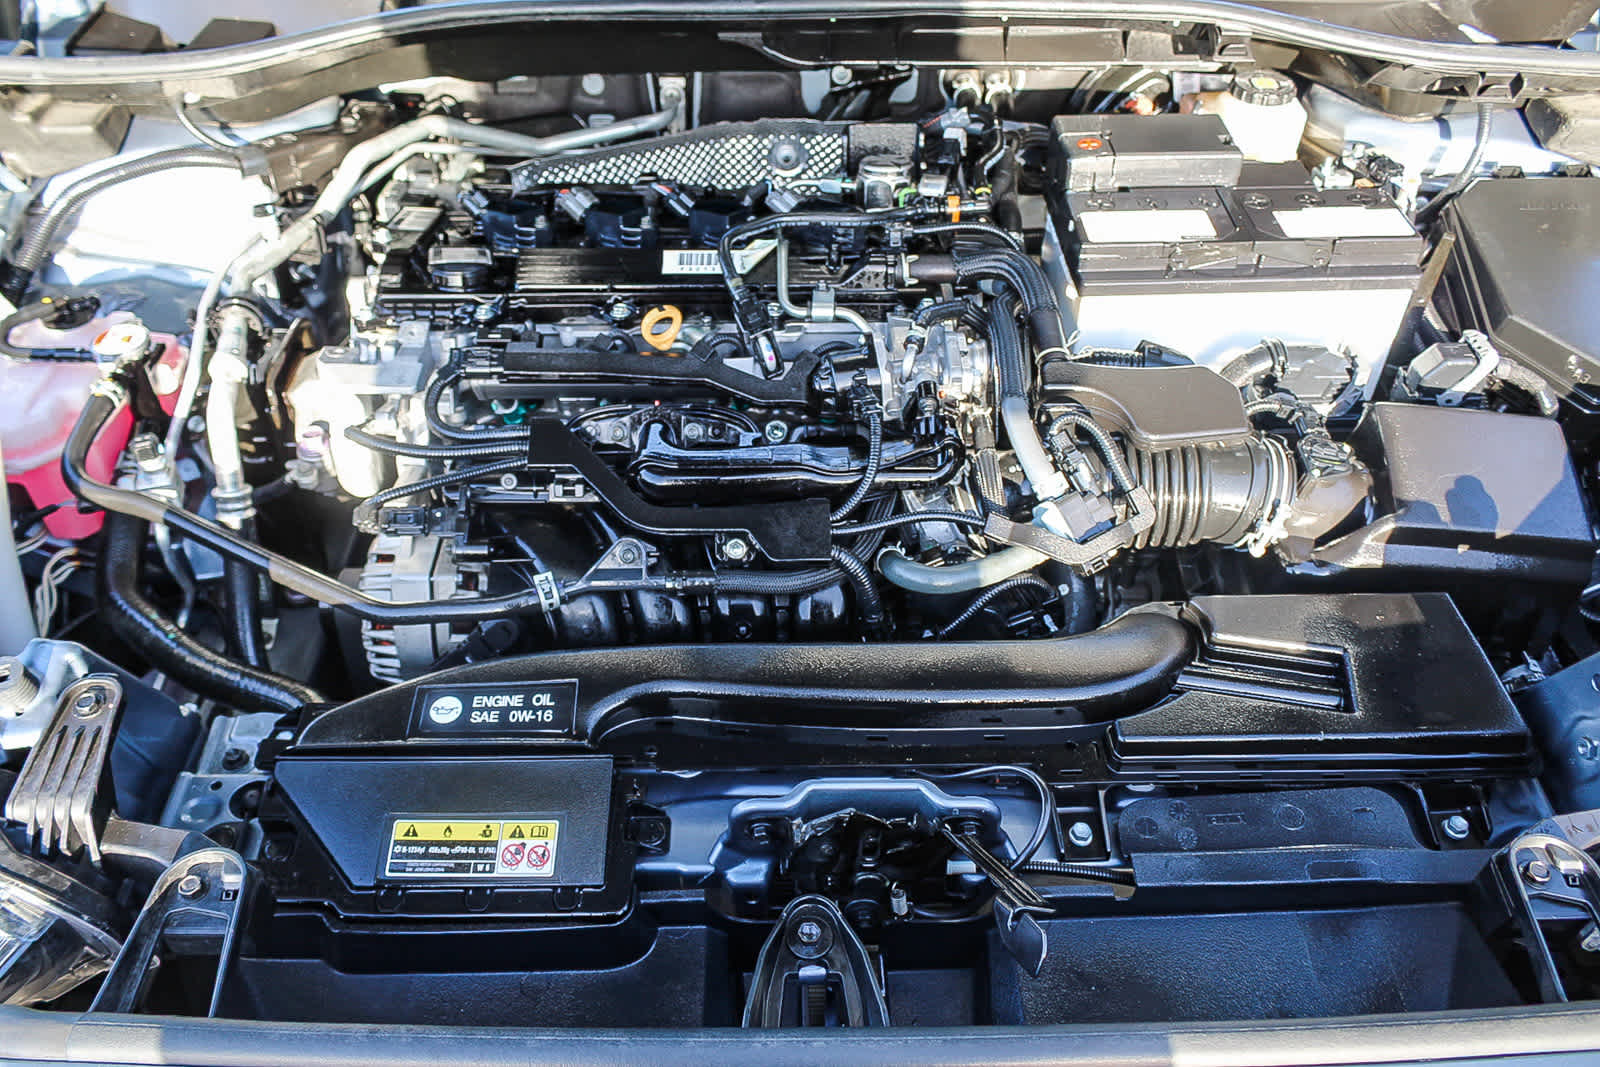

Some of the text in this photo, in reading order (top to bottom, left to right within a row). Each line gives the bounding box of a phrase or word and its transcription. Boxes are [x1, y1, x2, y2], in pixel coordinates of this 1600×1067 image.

[472, 693, 555, 708] ENGINE OIL
[470, 709, 553, 723] SAE 0W-16
